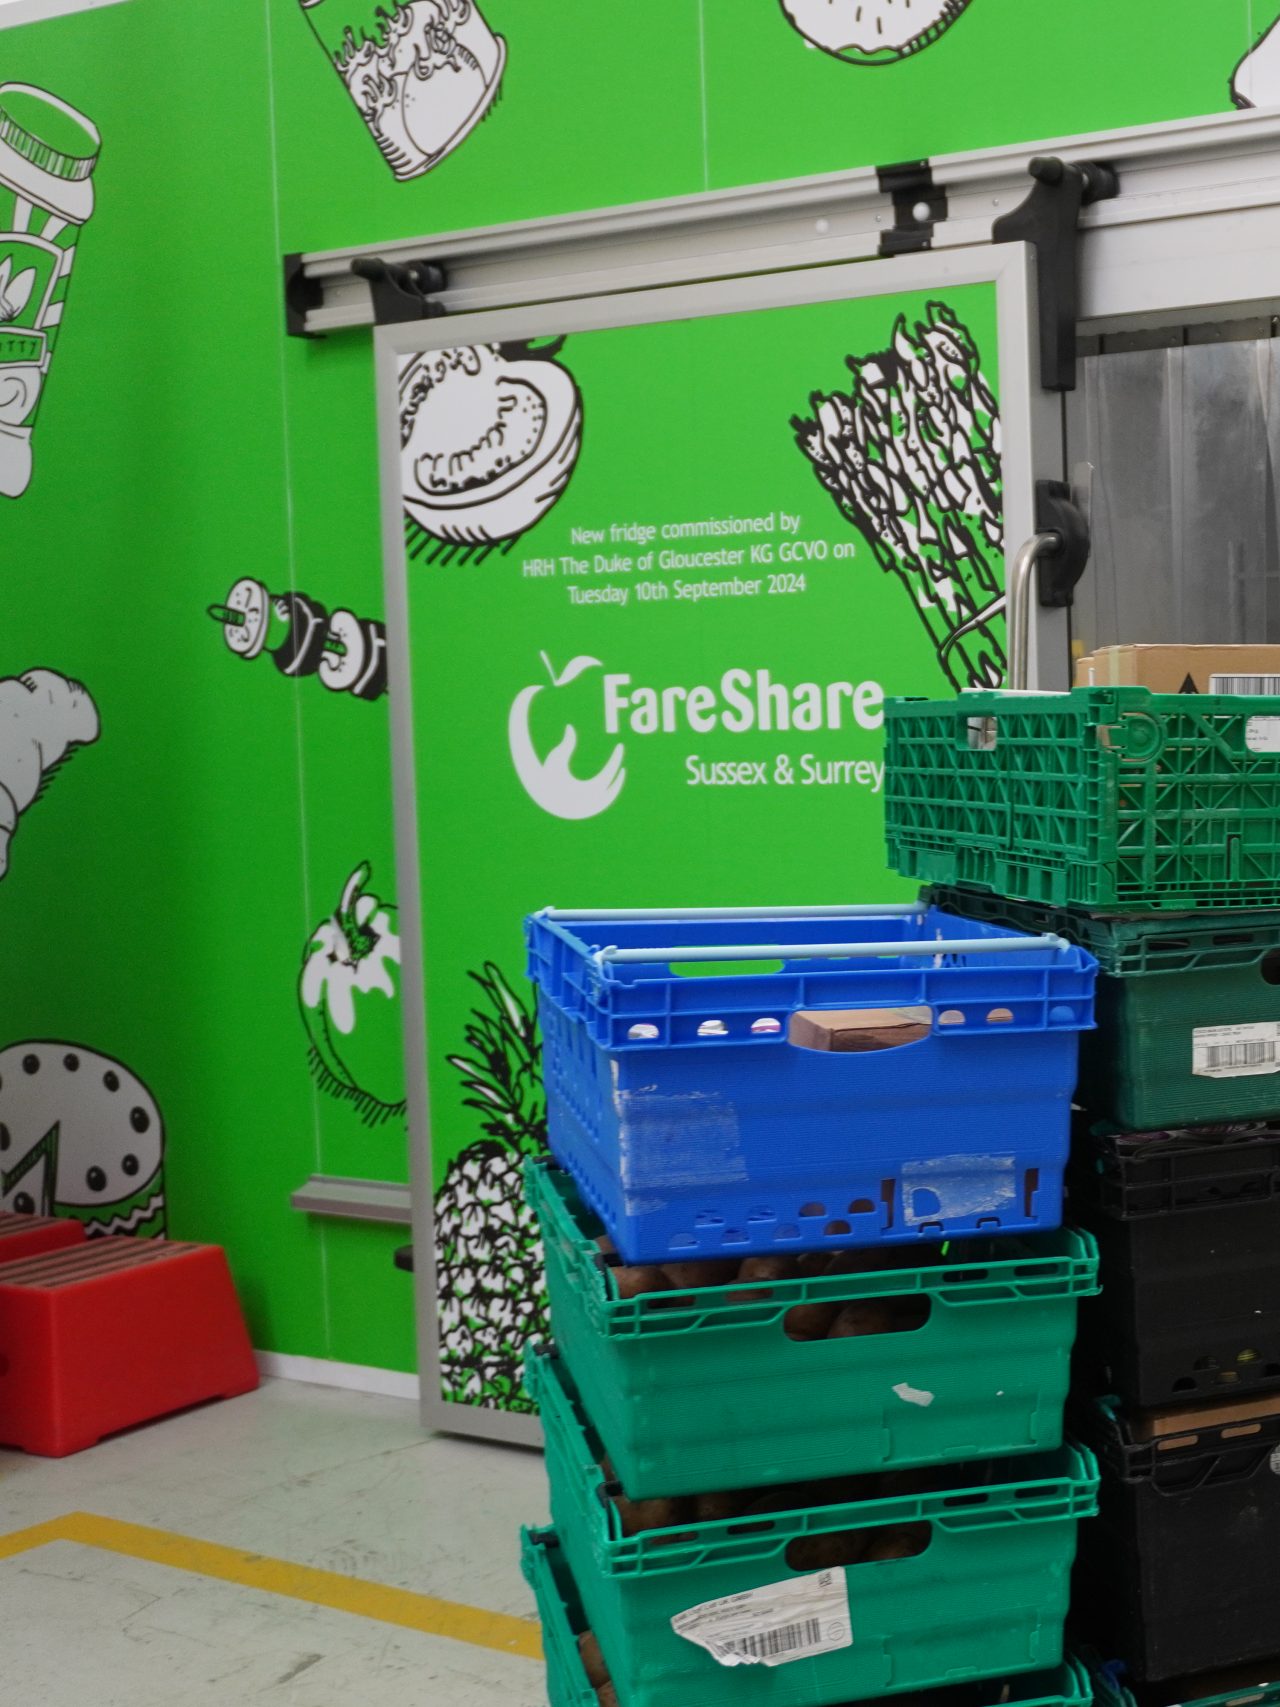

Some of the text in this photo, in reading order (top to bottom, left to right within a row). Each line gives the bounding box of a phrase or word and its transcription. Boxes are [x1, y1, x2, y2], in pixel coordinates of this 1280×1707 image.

[570, 510, 802, 547] New fridge commissioned by
[521, 538, 857, 578] HRH The Duke of Gloucester KG GCVO on
[566, 571, 808, 607] Tuesday 10th September 2024
[603, 668, 884, 734] FareShare
[686, 754, 884, 793] Sussex & Surrey
